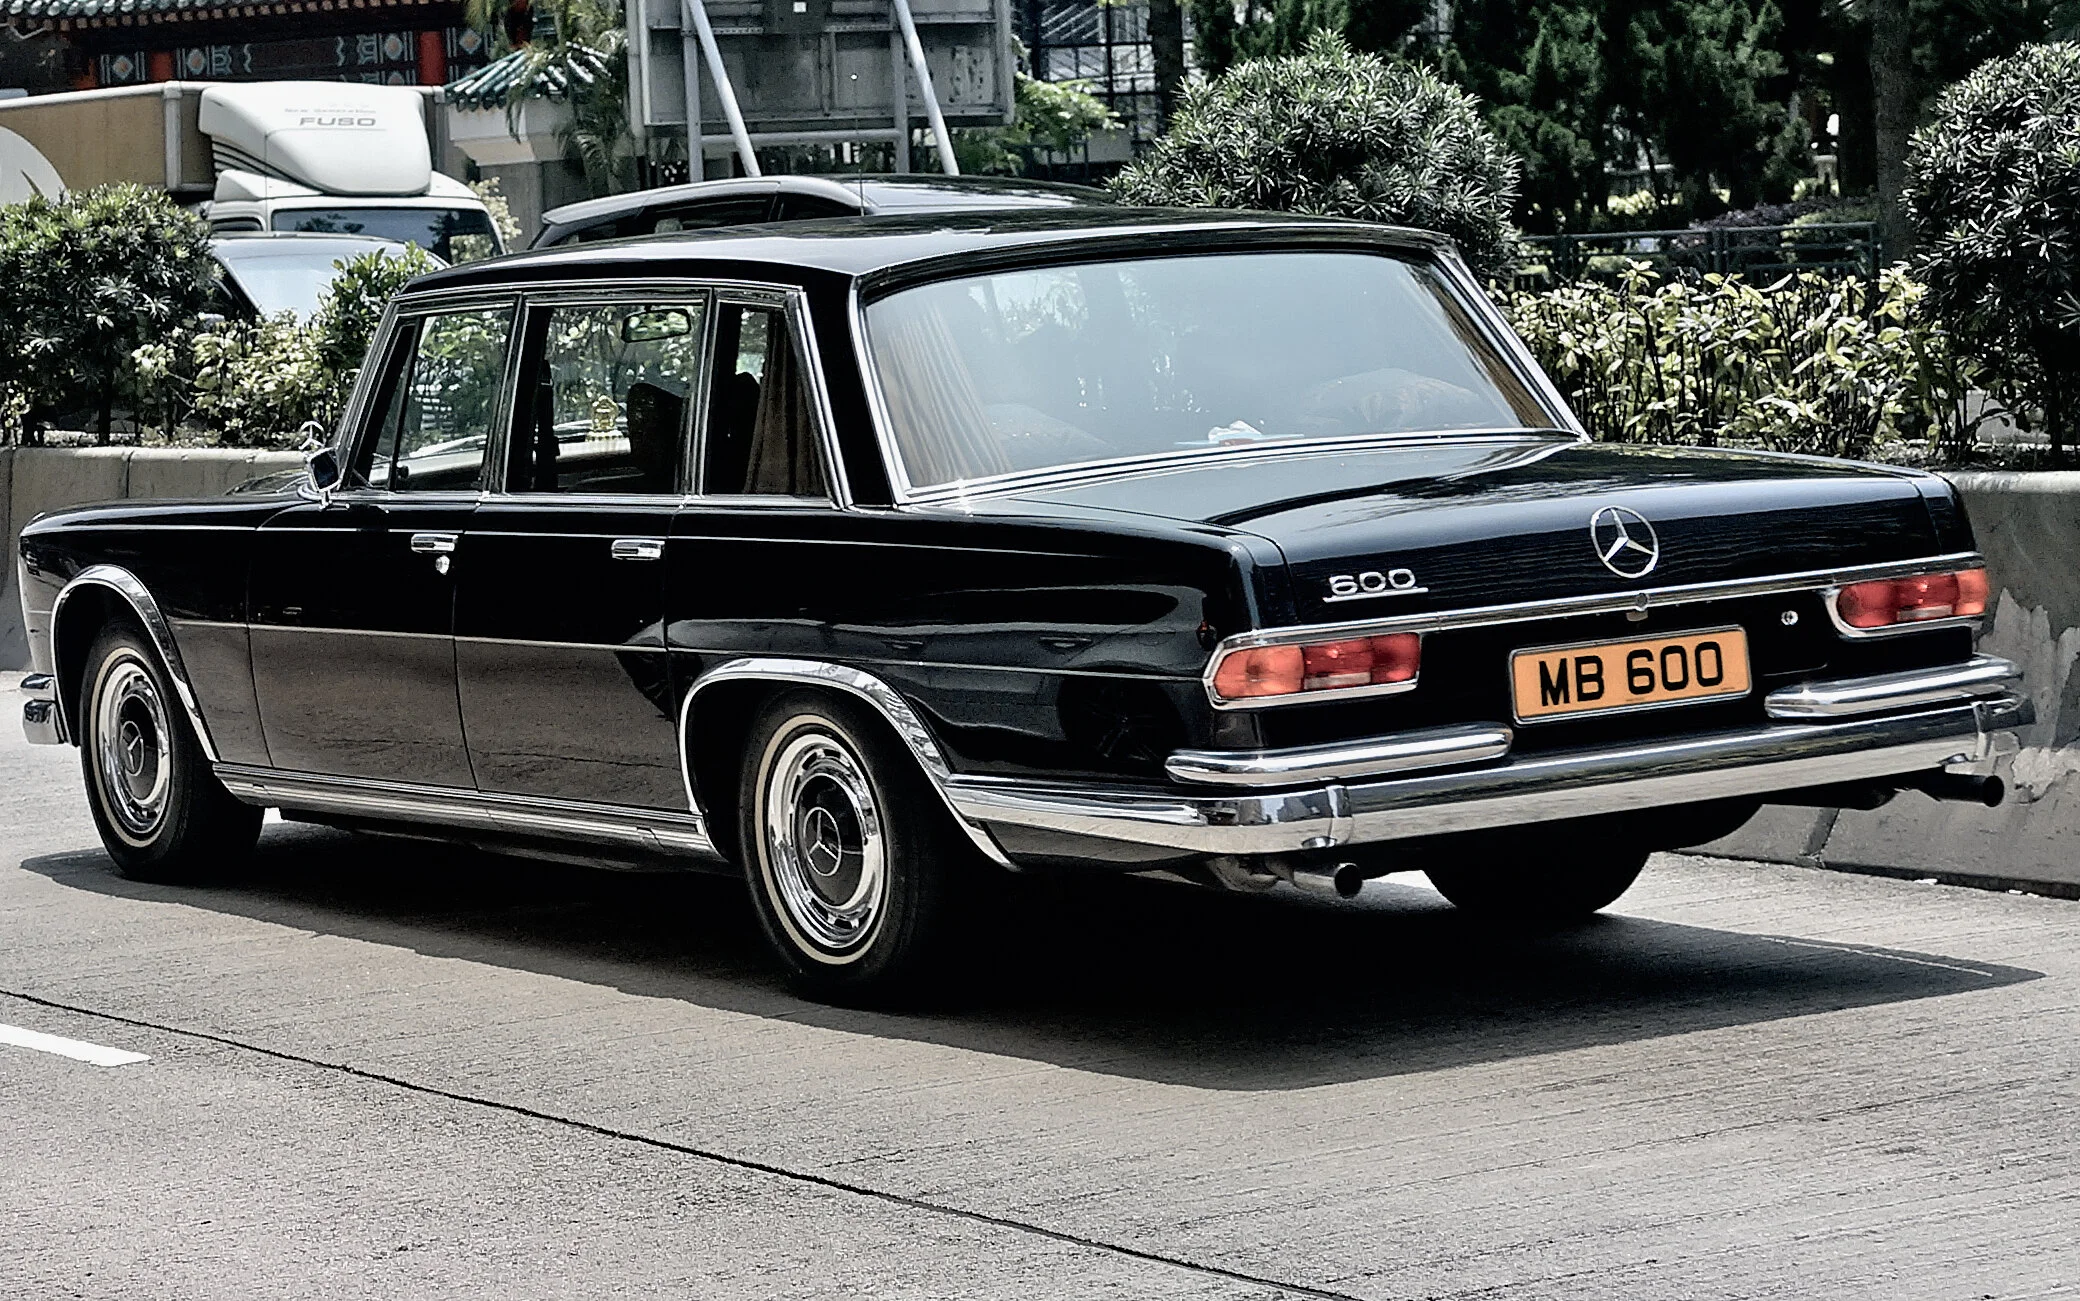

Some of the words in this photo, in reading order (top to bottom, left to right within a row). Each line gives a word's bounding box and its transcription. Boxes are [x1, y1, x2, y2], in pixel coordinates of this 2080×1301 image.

[300, 117, 376, 126] FUSO
[1329, 568, 1416, 597] 600
[1539, 655, 1605, 706] MB
[1626, 641, 1724, 695] 600
